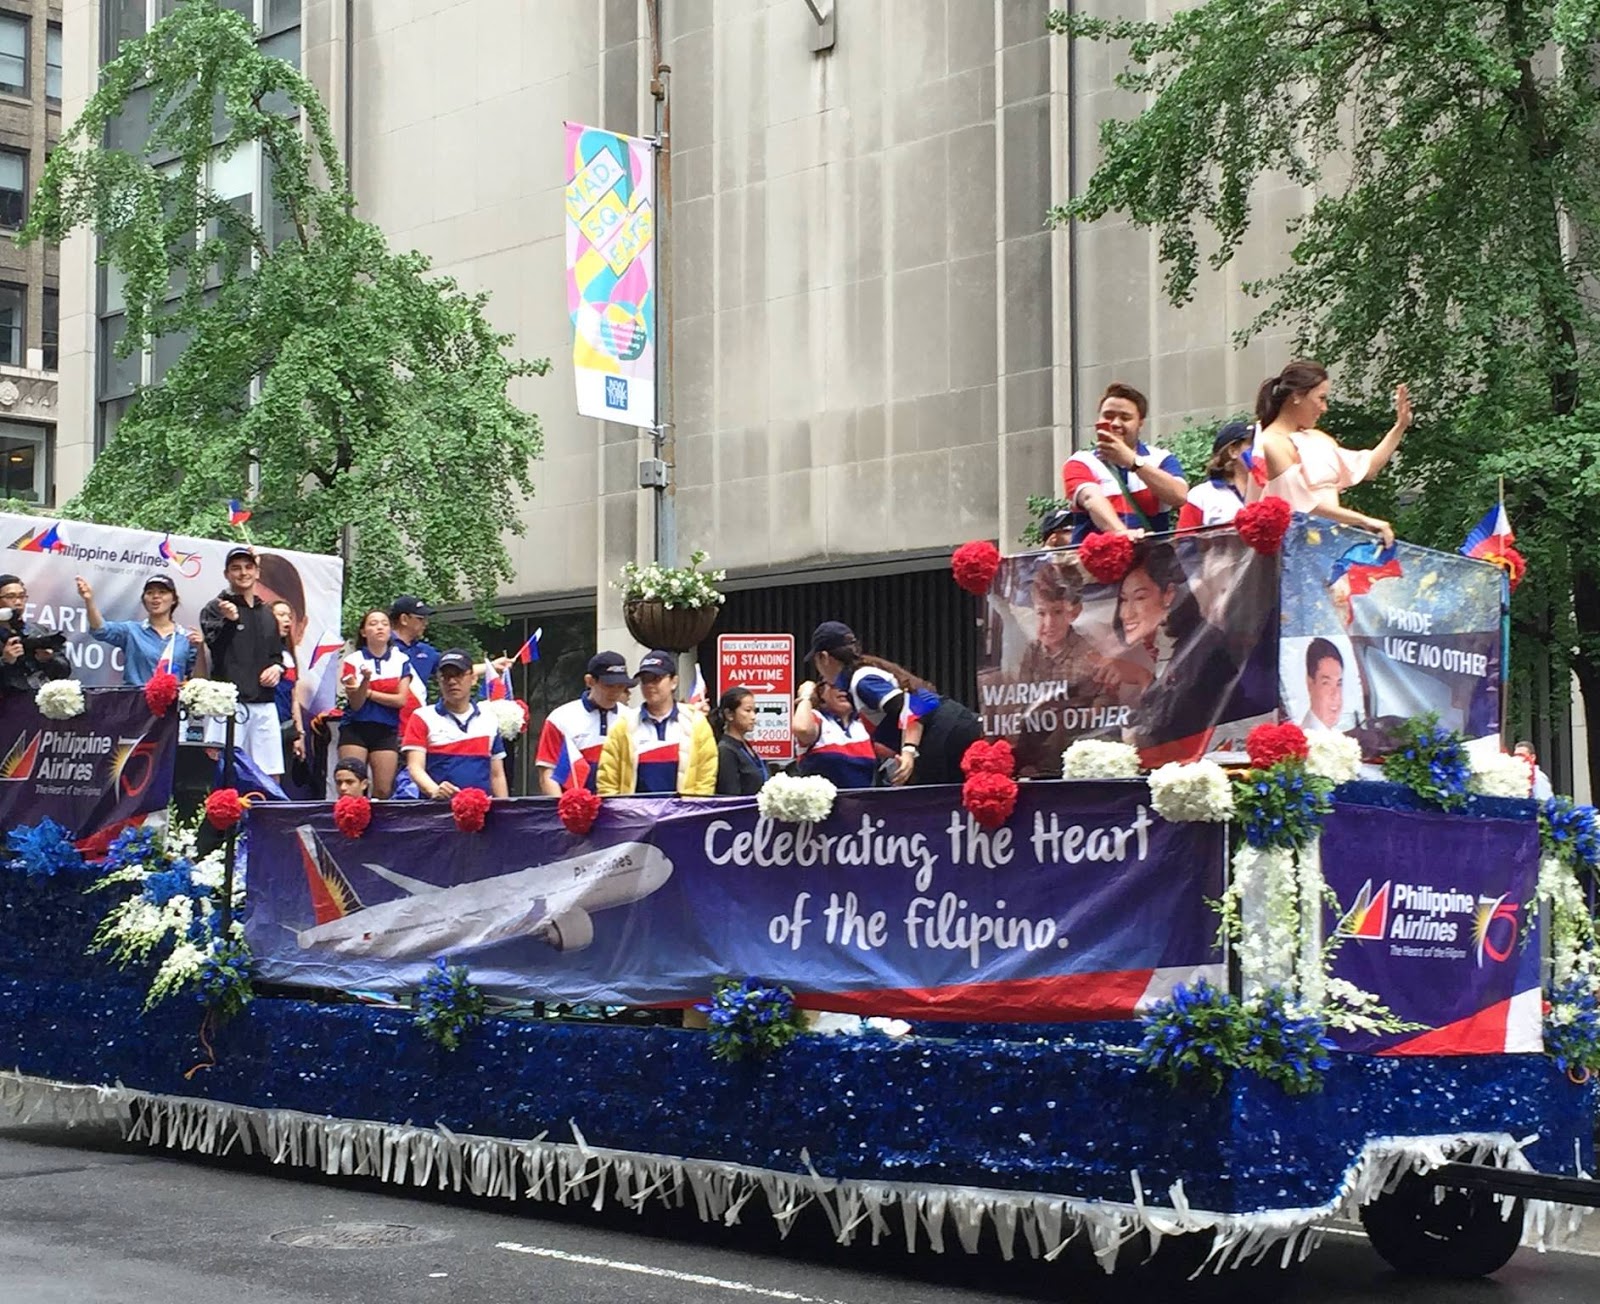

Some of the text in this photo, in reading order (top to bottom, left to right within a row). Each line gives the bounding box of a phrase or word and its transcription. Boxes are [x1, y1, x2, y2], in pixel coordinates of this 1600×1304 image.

[609, 396, 625, 408] LIFE
[120, 550, 170, 568] Airlines
[1386, 606, 1433, 635] PRIDE
[65, 641, 104, 669] NO
[771, 642, 788, 650] AREA
[1384, 636, 1488, 677] LIKE NO OTHER
[722, 654, 790, 666] NO STANDING
[728, 669, 784, 681] ANYTIME
[982, 680, 1069, 706] WARMTH
[982, 705, 1132, 735] LIKE NO OTHER
[40, 731, 112, 760] Philippine
[36, 757, 93, 780] Airlines
[704, 804, 1154, 892] Celebrating the Heart
[1392, 884, 1474, 918] Philippine
[768, 892, 813, 951] of
[823, 892, 889, 951] the
[1389, 914, 1458, 941] Airlines
